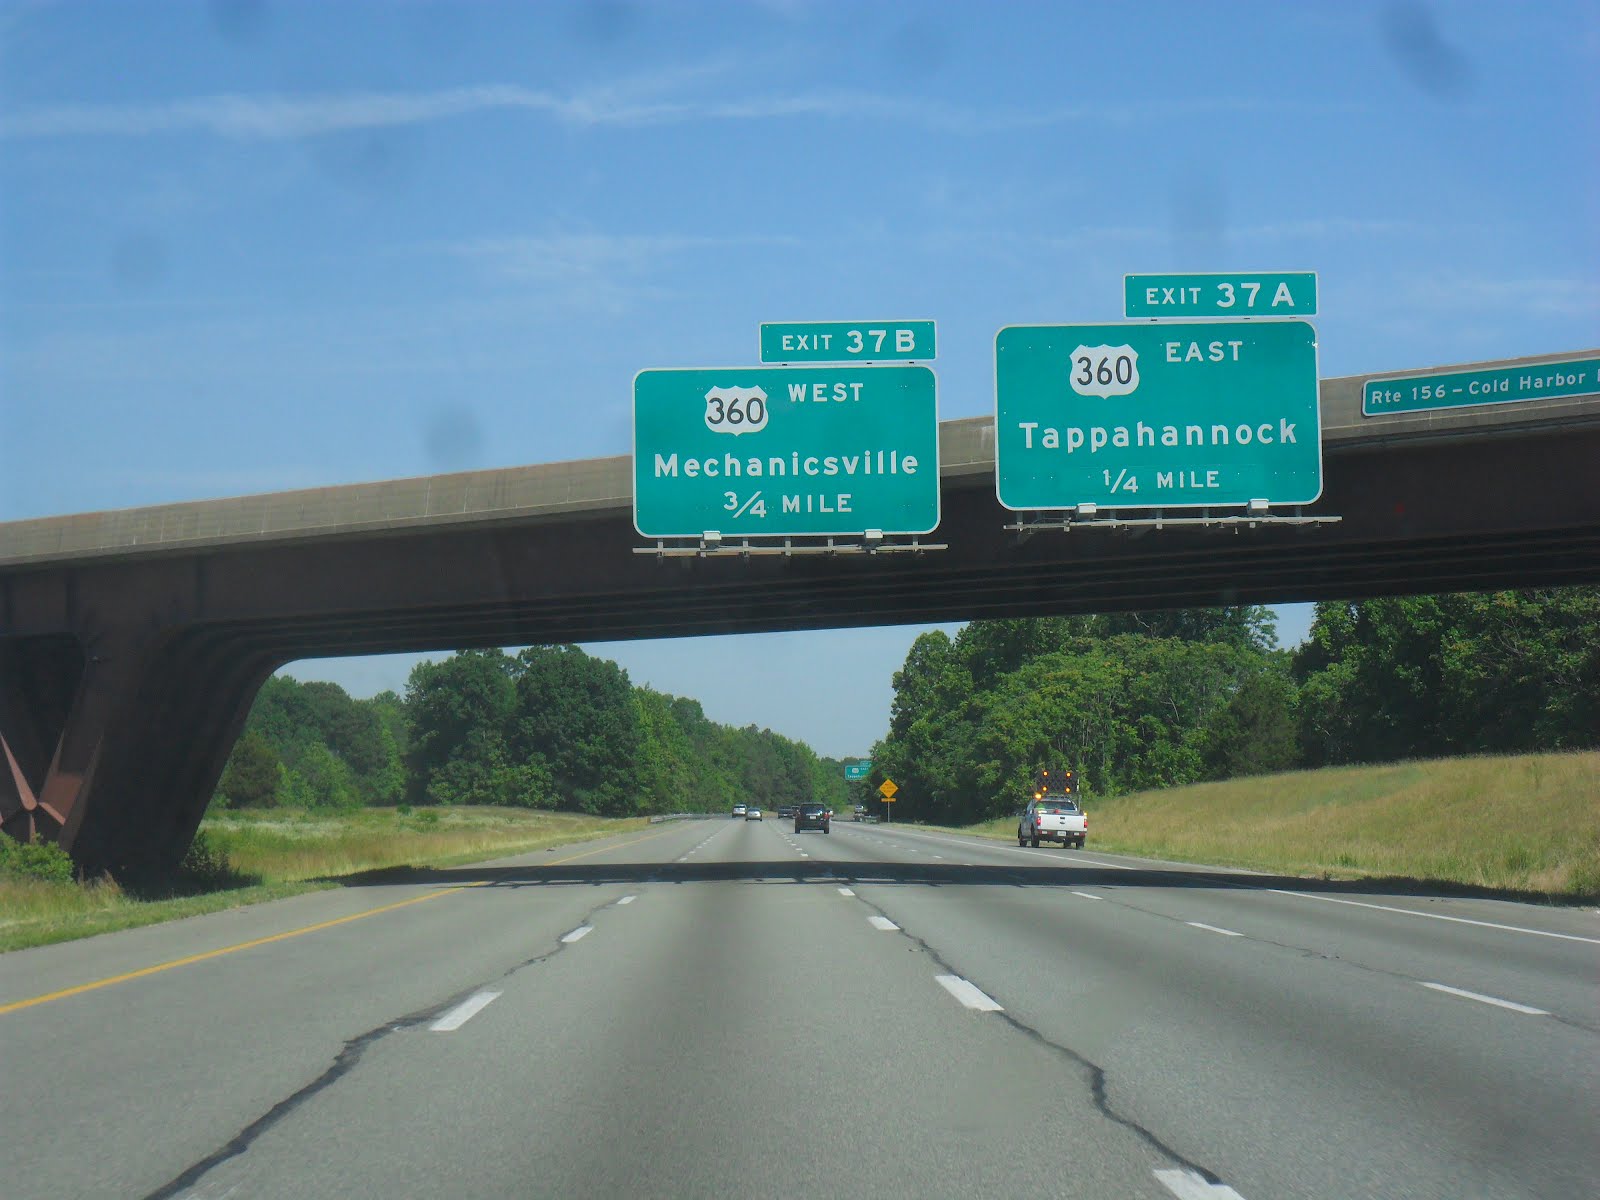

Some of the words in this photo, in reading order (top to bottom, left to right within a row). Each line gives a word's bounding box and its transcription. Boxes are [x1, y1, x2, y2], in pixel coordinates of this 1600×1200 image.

[1146, 287, 1201, 304] EXIT
[782, 335, 832, 350] EXIT
[1166, 340, 1243, 362] EAST
[1076, 355, 1133, 386] 360
[788, 383, 864, 402] WEST
[1371, 390, 1402, 405] Rte
[1468, 378, 1509, 396] Cold
[1519, 372, 1586, 391] Harbor
[707, 397, 765, 424] 360
[1019, 418, 1297, 453] Tappahannock
[654, 450, 919, 478] Mechanicsville
[1103, 469, 1139, 494] 1/4
[1157, 470, 1220, 489] MILE
[723, 490, 767, 518] 3/4
[782, 493, 853, 513] MILE
